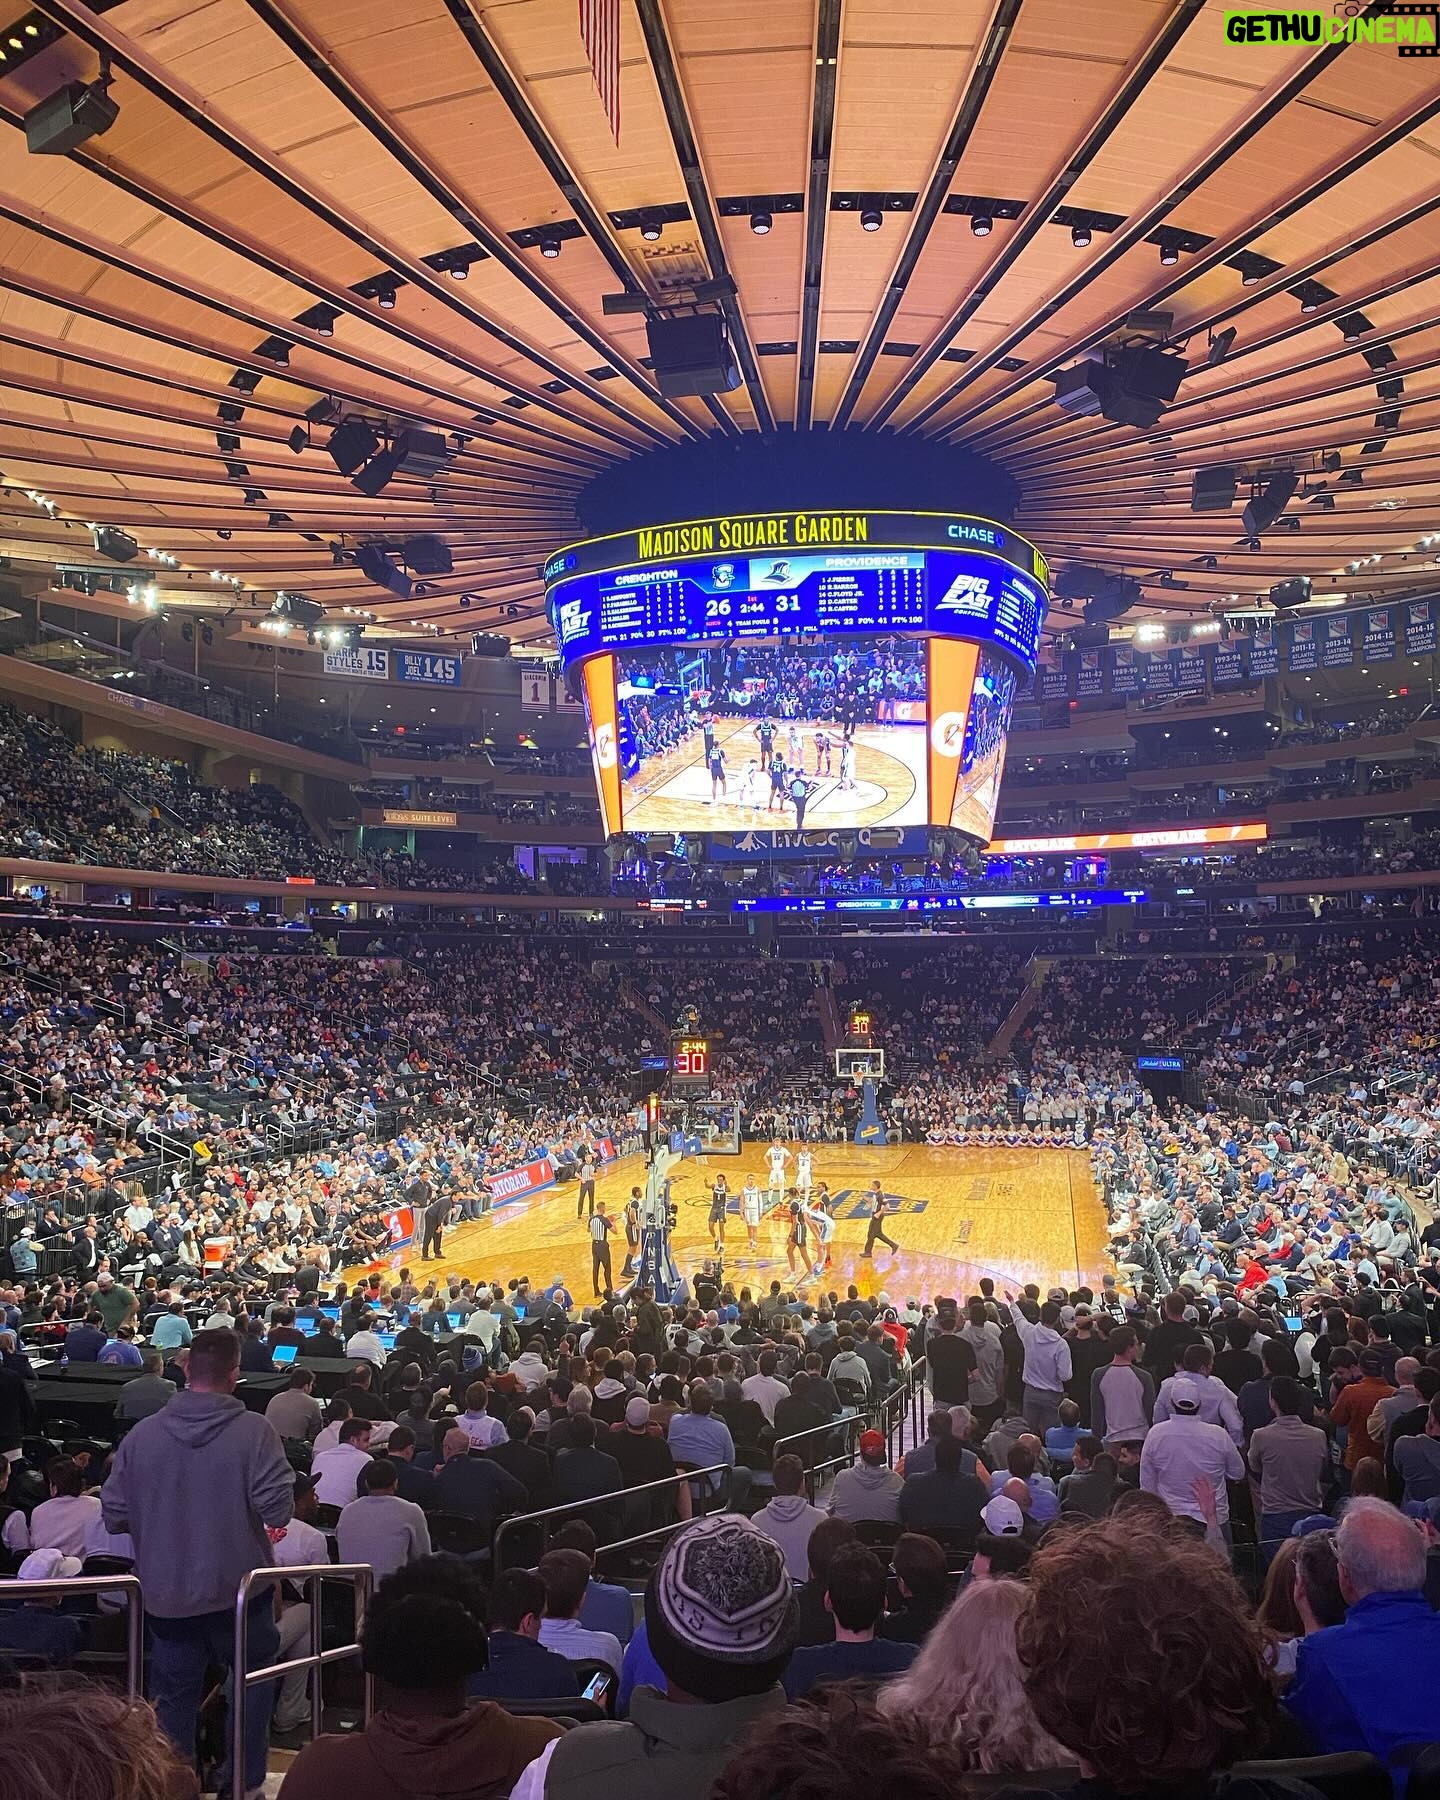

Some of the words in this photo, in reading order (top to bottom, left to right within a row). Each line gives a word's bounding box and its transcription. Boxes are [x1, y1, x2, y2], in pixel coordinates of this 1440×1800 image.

[639, 526, 713, 558] MADISON
[720, 521, 788, 549] SQUARE
[795, 515, 867, 542] GARDEN
[948, 525, 994, 543] CHASE
[825, 556, 908, 567] PROVIDENCE
[615, 570, 678, 585] CREIGHTON
[951, 575, 989, 593] BIG
[776, 594, 800, 611] 31
[942, 589, 994, 609] EAST
[706, 599, 731, 616] 26
[740, 603, 764, 613] 2:44
[1407, 623, 1434, 635] 2014-15
[1326, 638, 1351, 648] 2013-14
[1365, 632, 1393, 642] 2014-15
[1292, 643, 1316, 652] 2011-12
[1407, 643, 1436, 653] CHAMPIONS
[327, 656, 362, 668] STYLES
[367, 650, 386, 671] 15
[405, 655, 422, 666] BILLY
[406, 666, 421, 676] JOEL
[424, 657, 455, 679] 145
[108, 692, 135, 707] CHASE
[532, 682, 539, 702] 1
[682, 1042, 706, 1053] 2:44
[678, 1054, 704, 1073] 30
